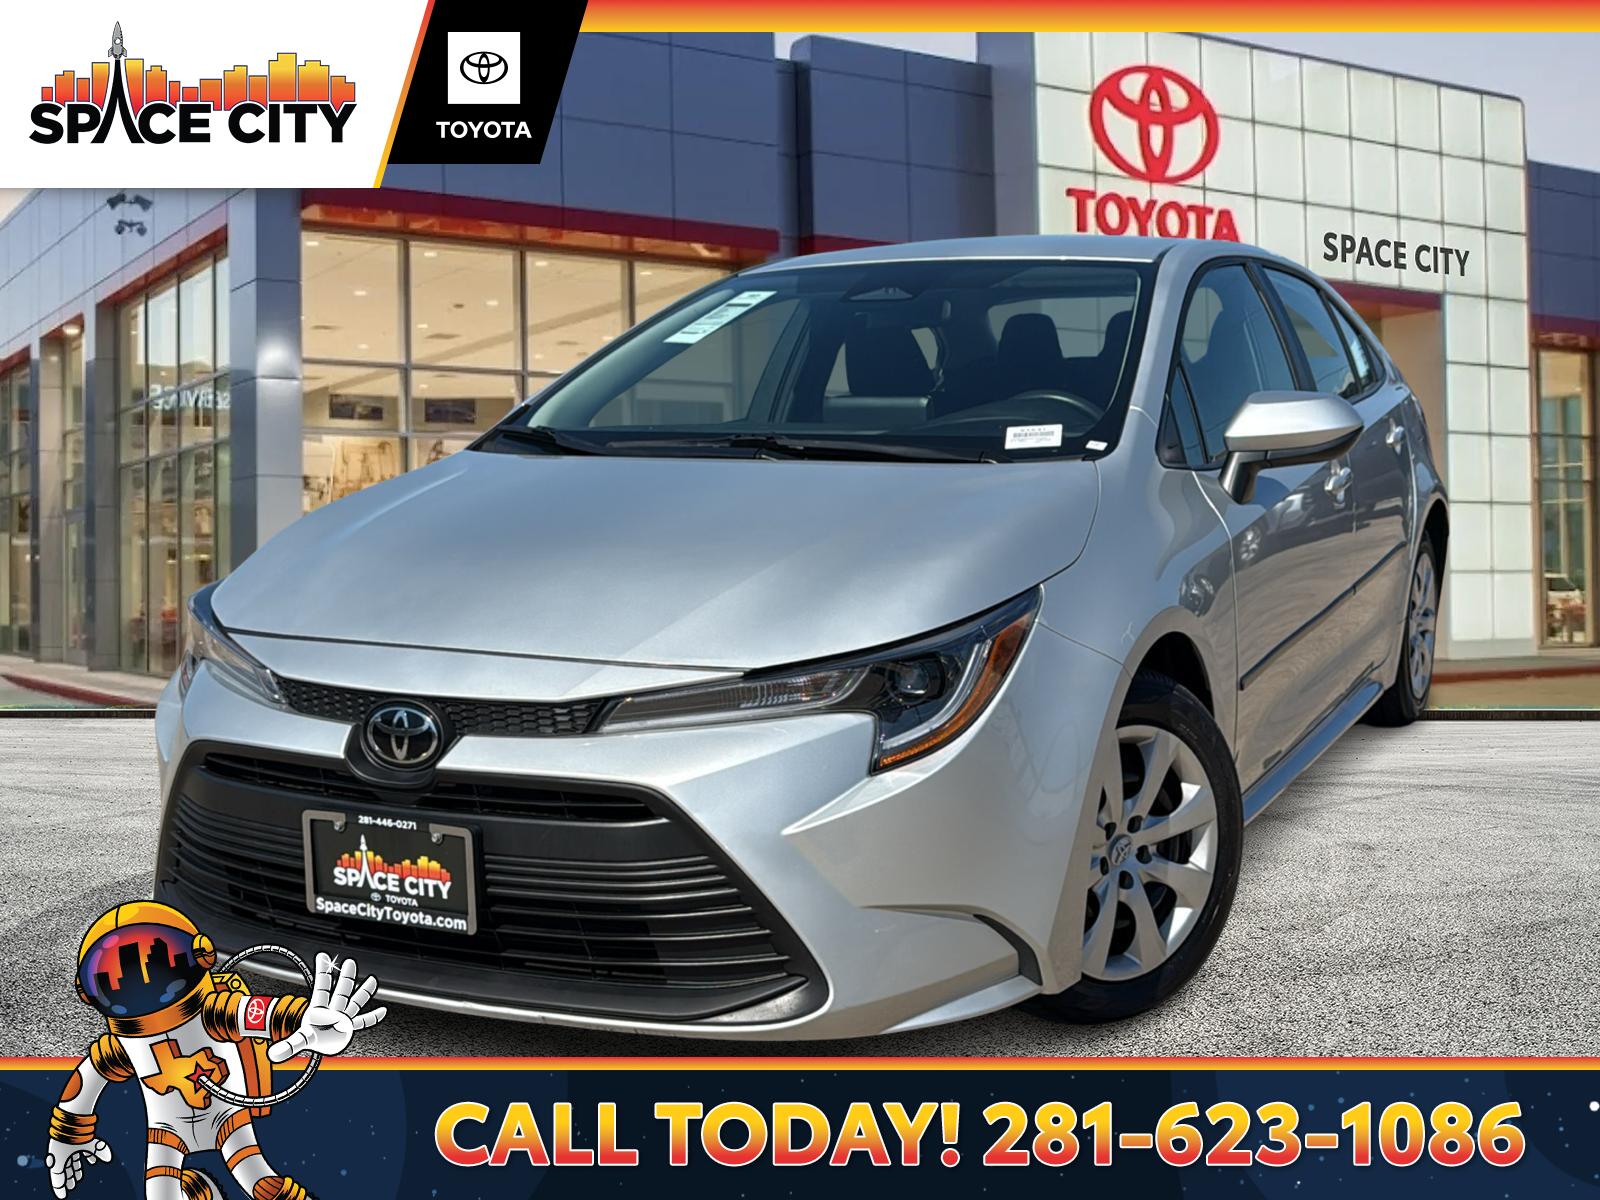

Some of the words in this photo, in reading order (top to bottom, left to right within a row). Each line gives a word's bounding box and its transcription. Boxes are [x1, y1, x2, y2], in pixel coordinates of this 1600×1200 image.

[1065, 187, 1241, 243] TOYOTA
[1323, 232, 1407, 270] SPACE
[1415, 244, 1470, 277] CITY
[358, 815, 417, 830] 281-446-0271
[333, 858, 400, 892] SPACE
[404, 876, 452, 899] CITY
[316, 896, 467, 931] SpaceCityToyota.com
[385, 894, 418, 908] TOYOTA
